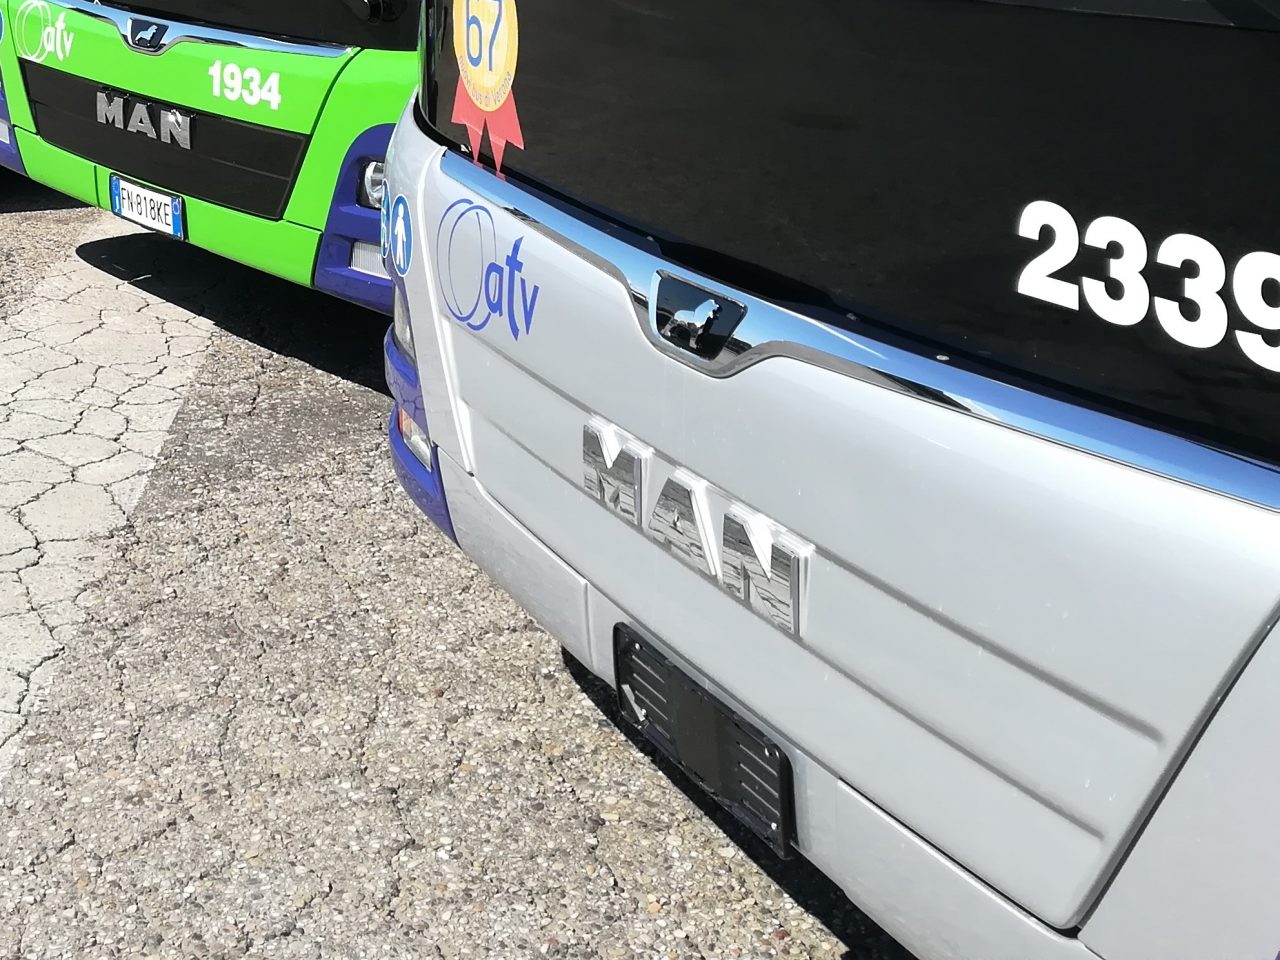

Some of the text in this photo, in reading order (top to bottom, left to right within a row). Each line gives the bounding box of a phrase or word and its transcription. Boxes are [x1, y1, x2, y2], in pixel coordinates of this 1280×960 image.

[43, 11, 74, 61] atv
[96, 90, 192, 150] MAN
[208, 59, 282, 111] 1934
[484, 235, 540, 342] atv
[1017, 199, 1280, 374] 2339
[582, 416, 810, 637] MAN
